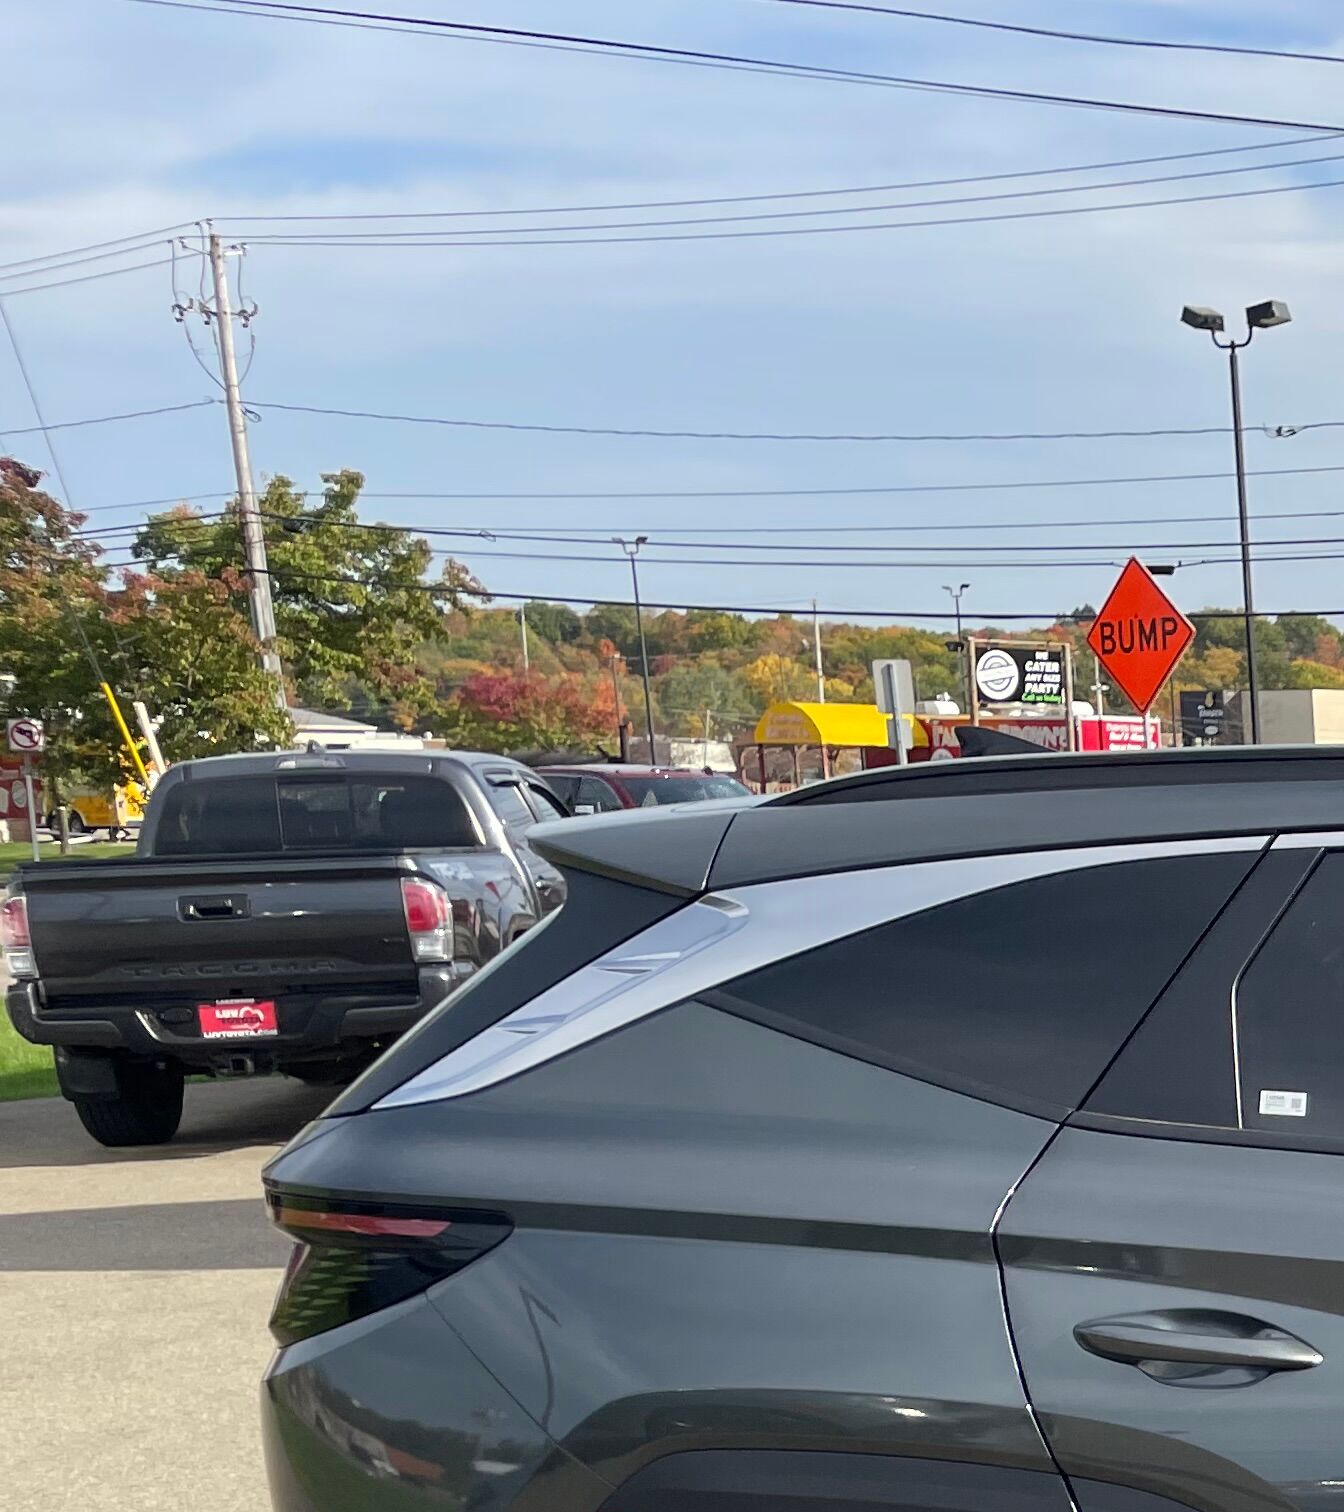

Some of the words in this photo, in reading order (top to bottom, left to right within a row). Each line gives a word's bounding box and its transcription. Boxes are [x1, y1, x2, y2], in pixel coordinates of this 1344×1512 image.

[1100, 617, 1178, 656] BUMP
[1024, 660, 1060, 672] CATER
[1024, 683, 1060, 694] PARTY
[120, 959, 337, 978] TACOMA
